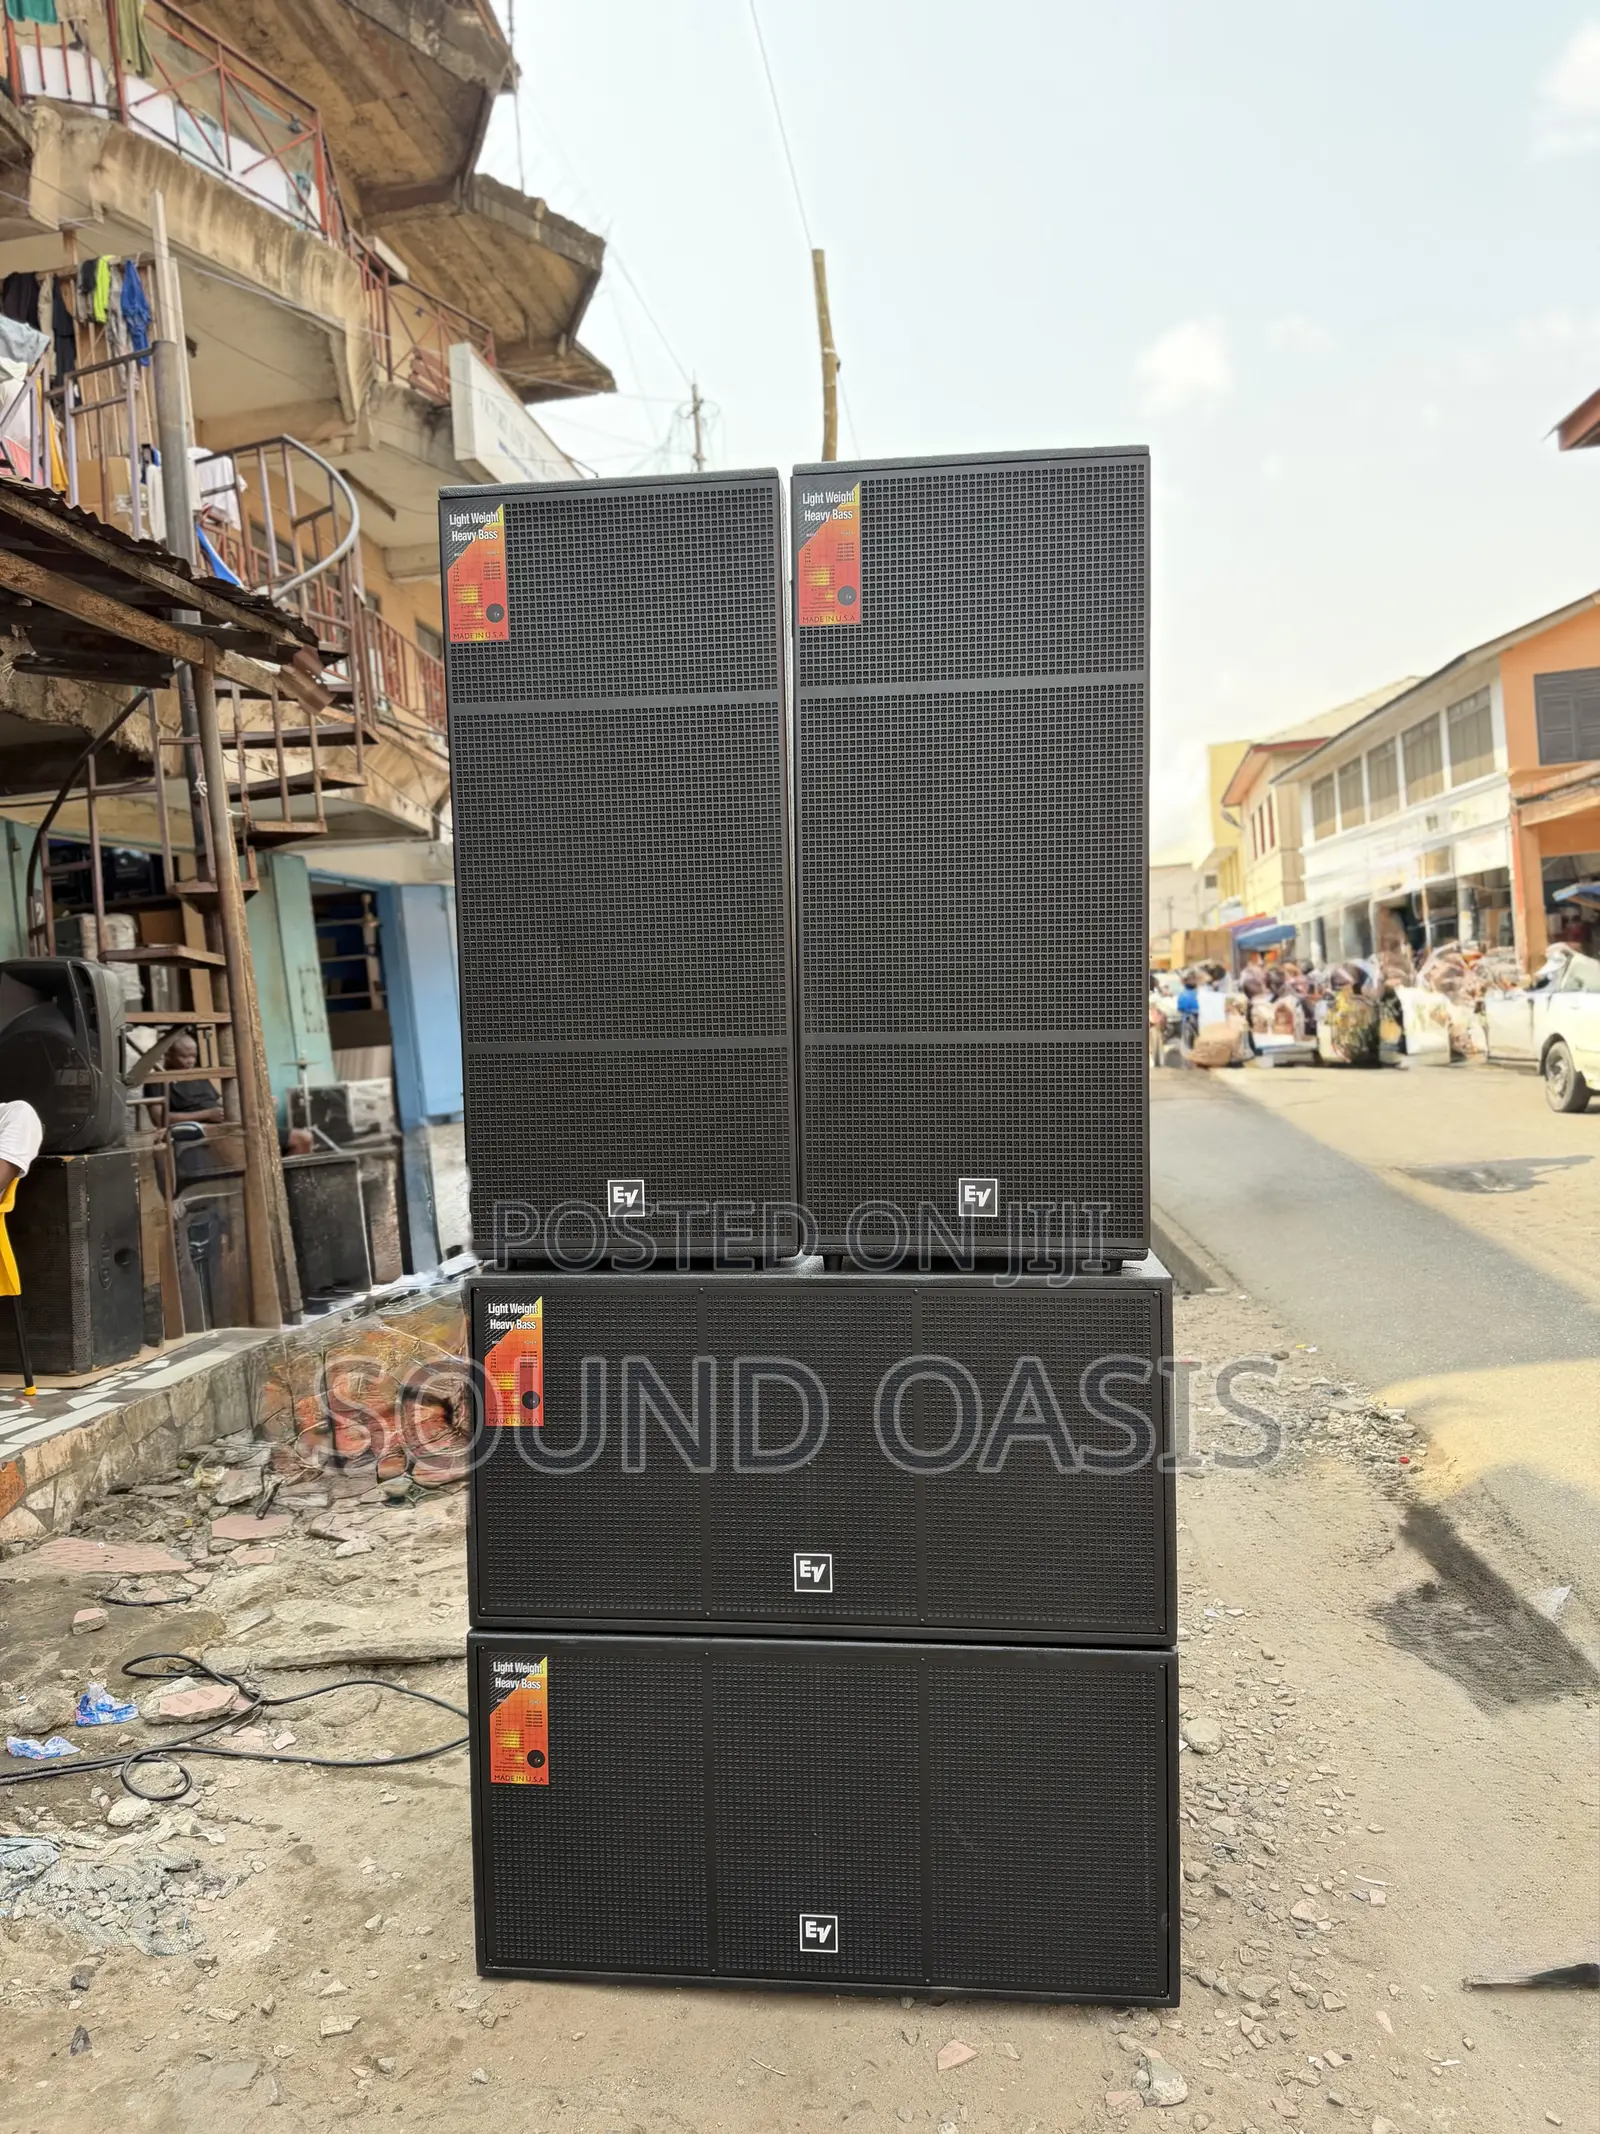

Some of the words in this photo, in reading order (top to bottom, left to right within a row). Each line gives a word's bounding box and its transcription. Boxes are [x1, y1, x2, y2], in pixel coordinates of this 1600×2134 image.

[802, 492, 824, 506] Light
[825, 491, 855, 504] Weight
[449, 513, 470, 527] Light
[471, 511, 499, 525] Weight
[804, 510, 830, 523] Heavy
[832, 509, 853, 520] Bass
[451, 530, 477, 543] Heavy
[478, 529, 499, 540] Bass
[802, 615, 824, 623] MADE
[453, 632, 474, 640] MADE
[488, 1303, 509, 1316] Light
[510, 1303, 538, 1316] Weight
[490, 1319, 515, 1332] Heavy
[516, 1319, 536, 1330] Bass
[493, 1661, 514, 1674] Light
[515, 1662, 543, 1676] Weight
[495, 1677, 520, 1690] Heavy
[521, 1678, 541, 1689] Bass
